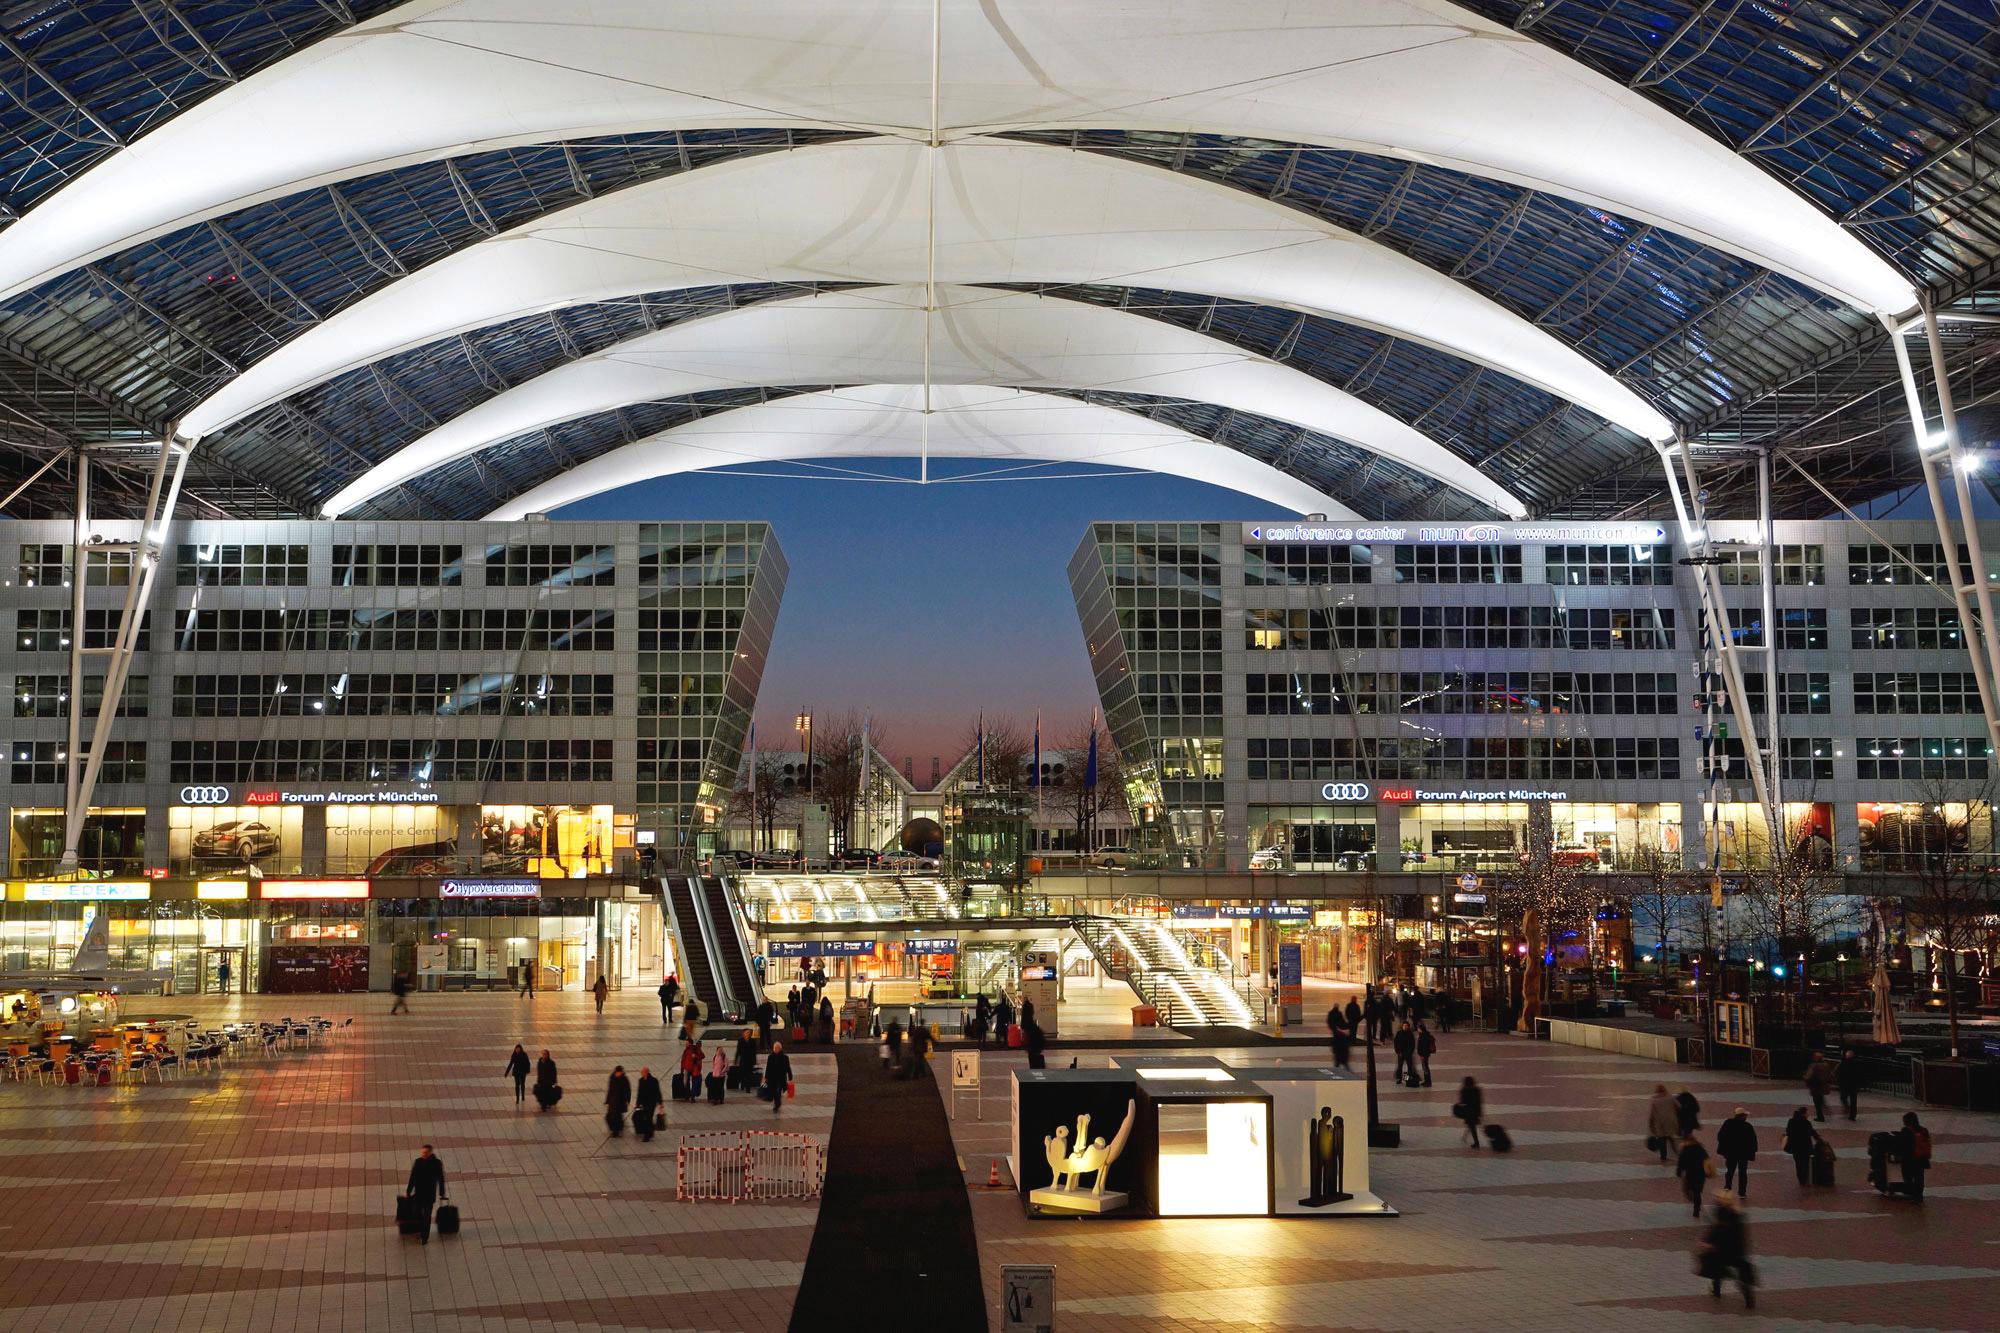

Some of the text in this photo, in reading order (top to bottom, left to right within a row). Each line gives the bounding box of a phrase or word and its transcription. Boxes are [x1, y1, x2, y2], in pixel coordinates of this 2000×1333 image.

[1266, 525, 1649, 542] conference center municon www.municon.de
[247, 791, 438, 804] Audi Forum Airport München
[1382, 790, 1567, 801] Audi Forum Airport München
[334, 826, 404, 836] Conference
[69, 885, 133, 896] EDEKA
[456, 882, 538, 897] HypoVereinsbank
